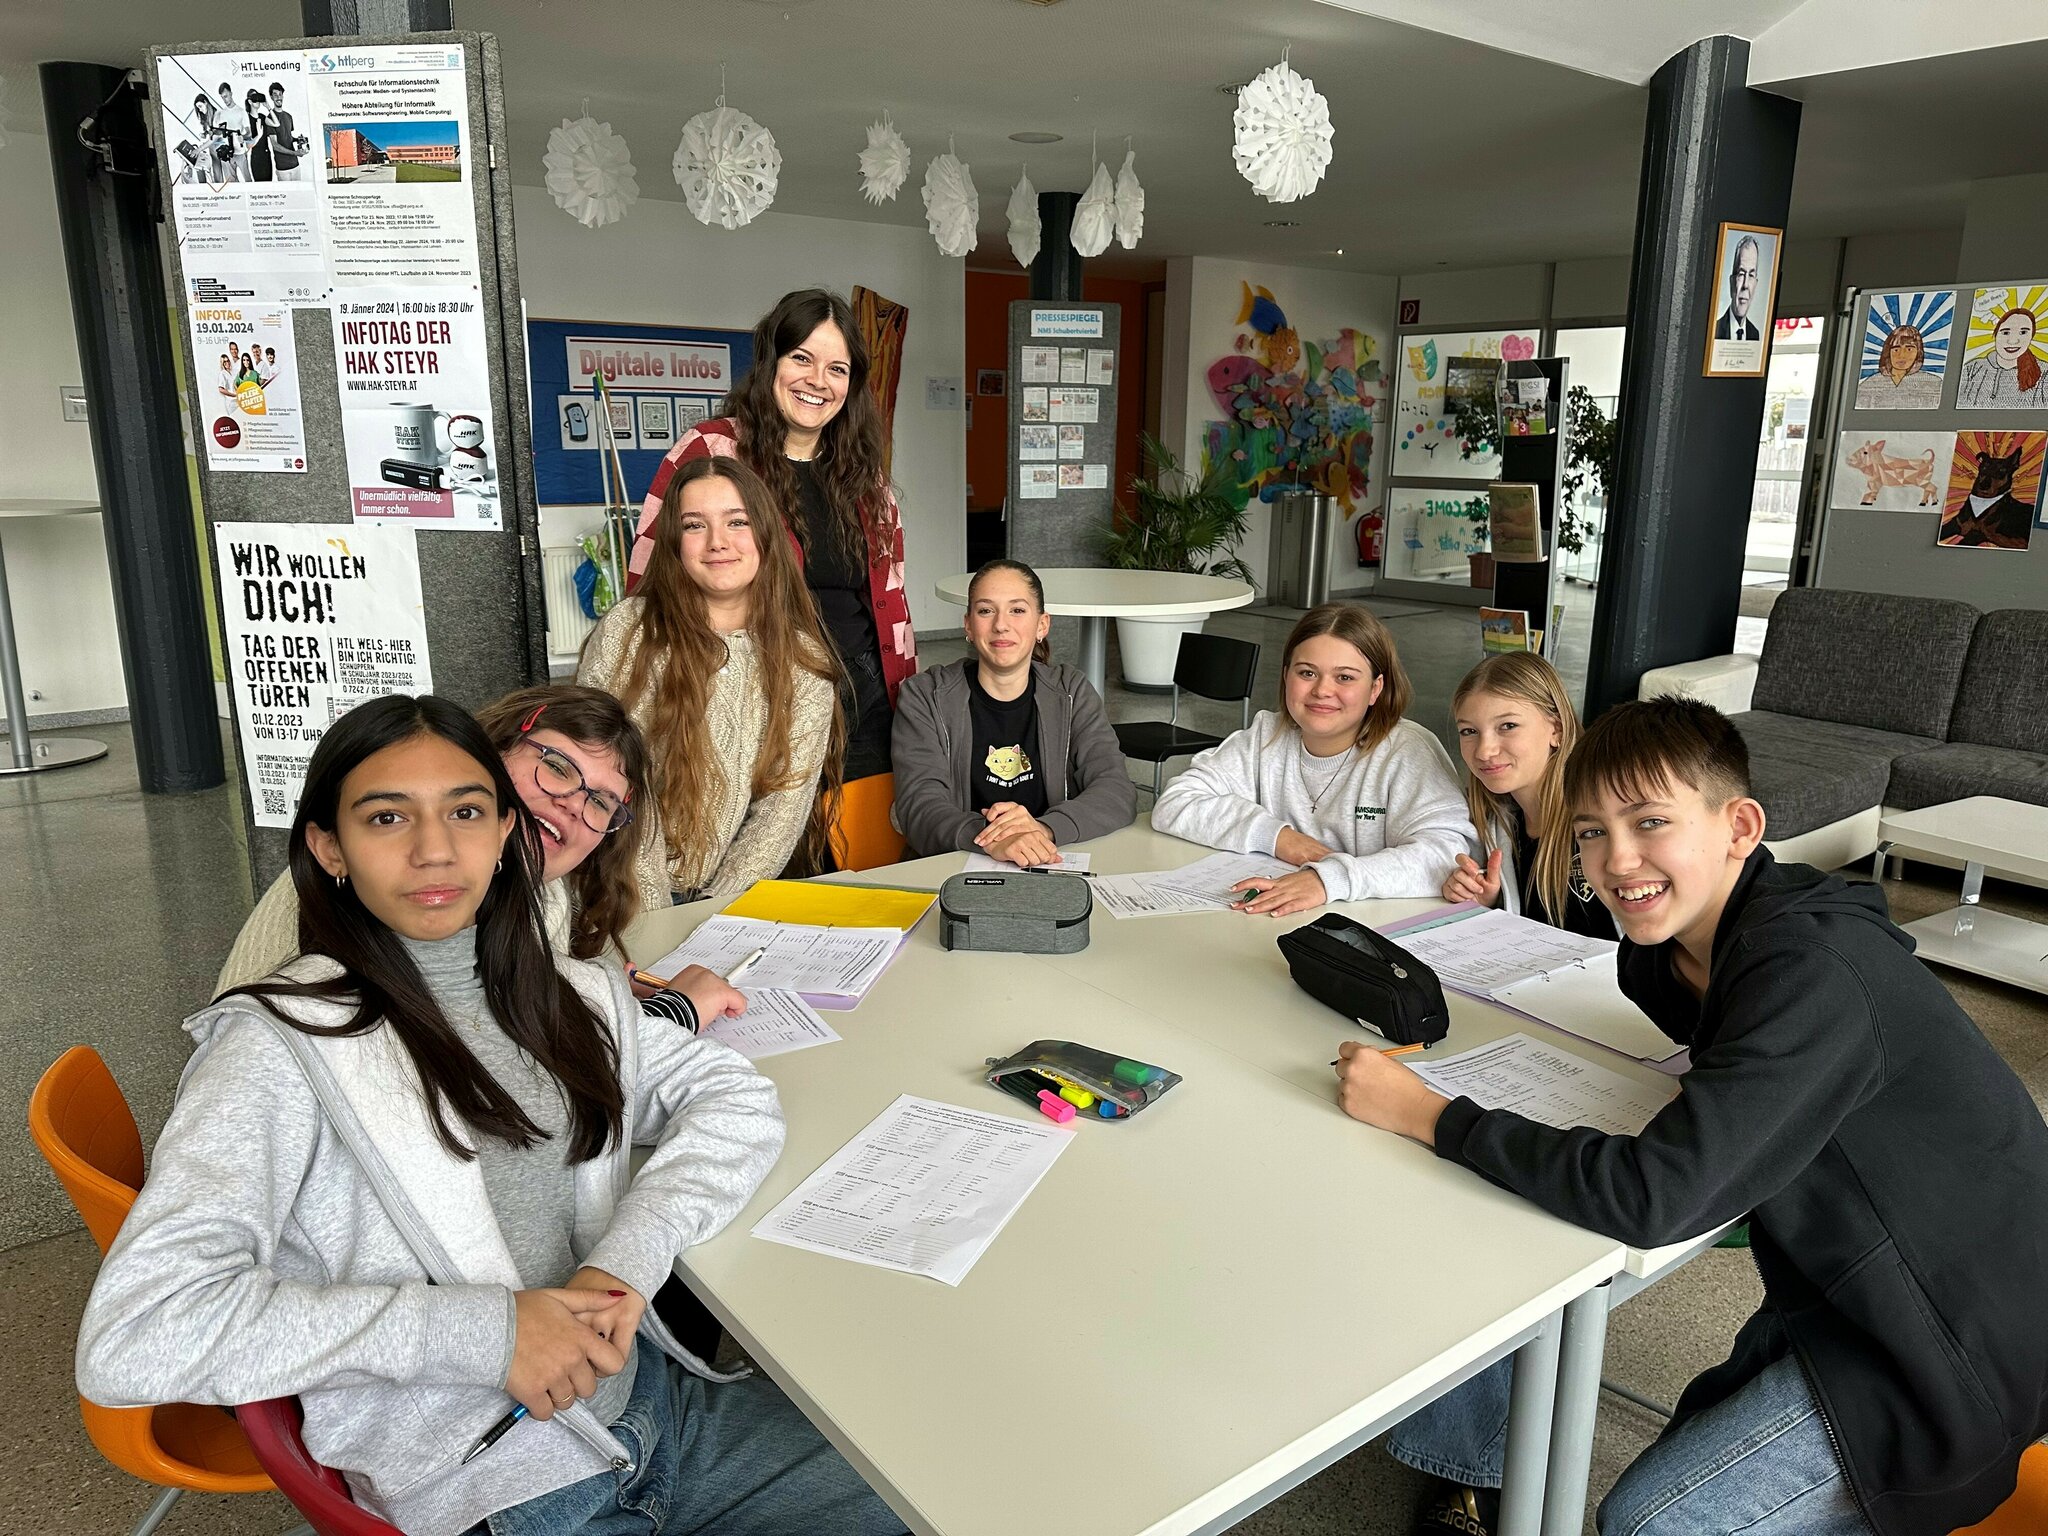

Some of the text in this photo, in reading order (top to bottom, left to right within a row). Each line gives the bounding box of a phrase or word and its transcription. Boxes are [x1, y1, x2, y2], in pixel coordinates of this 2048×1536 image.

[241, 61, 300, 72] HTL Leonding
[338, 55, 375, 68] htlperg
[378, 78, 440, 86] Informationstechnik
[364, 101, 393, 109] Abteilung
[340, 304, 349, 313] 19.
[351, 303, 375, 314] Jänner
[376, 303, 394, 313] 2024
[402, 303, 423, 313] 16:00
[424, 302, 436, 313] bis
[438, 302, 458, 312] 18:30
[460, 302, 474, 312] Uhr
[195, 309, 242, 320] INFOTAG
[1035, 313, 1101, 323] PRESSESPIEGEL
[196, 322, 254, 333] 19.01.2024
[341, 321, 451, 344] INFOTAG DER
[214, 336, 229, 344] UHR
[345, 351, 439, 374] HAK STEYR
[579, 349, 721, 382] Digitale Infos
[347, 380, 417, 391] WWW.HAK-STEYR.AT
[394, 425, 420, 437] HAK
[1519, 422, 1526, 432] 3
[359, 490, 443, 504] Unermüdlich vielfältig.
[361, 504, 411, 514] Immer schon.
[230, 543, 366, 579] WIR WOLLEN
[243, 579, 336, 624] DICH!
[241, 634, 320, 659] TAG DER
[337, 637, 354, 649] HTL
[357, 638, 383, 650] WELS
[390, 639, 412, 651] HIER
[338, 651, 416, 665] BIN ICH RICHTIG!
[245, 659, 328, 684] OFFENEN
[348, 670, 380, 678] SCHULJAHR
[341, 677, 379, 685] TELEFONISCHE
[348, 685, 364, 694] 7242
[372, 686, 380, 694] 65
[247, 685, 310, 708] TÜREN
[252, 713, 303, 726] 01.12.2023
[254, 727, 322, 741] VON 13-17 UHR
[258, 770, 285, 778] 13.10.2023
[1427, 1508, 1487, 1536] adidas
